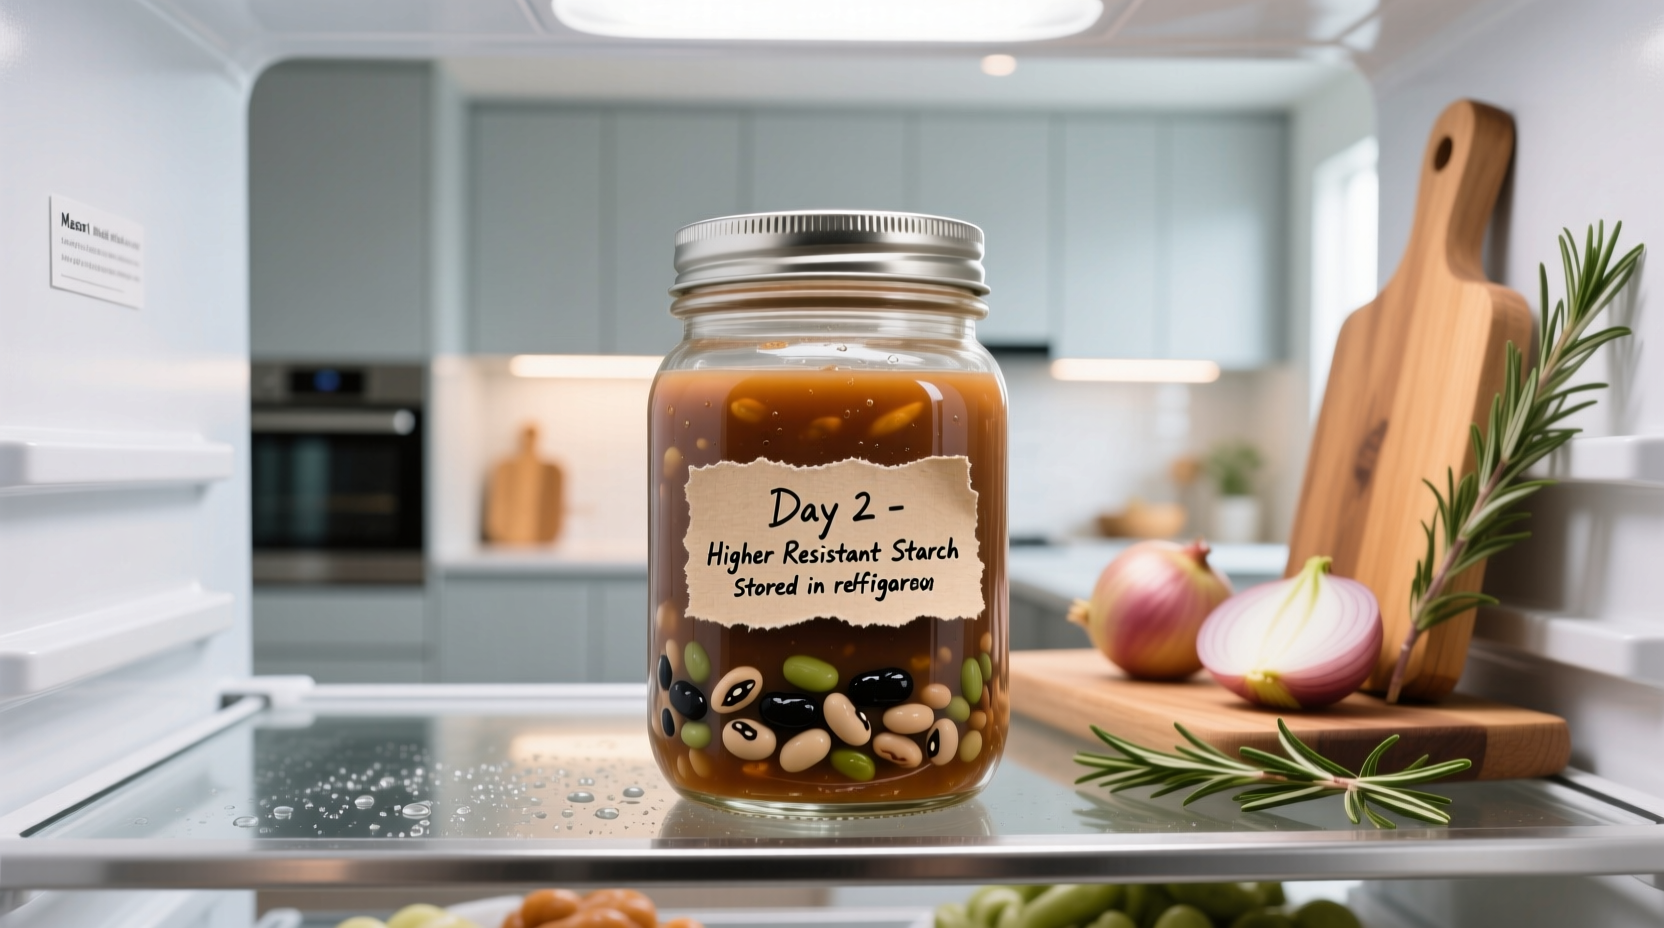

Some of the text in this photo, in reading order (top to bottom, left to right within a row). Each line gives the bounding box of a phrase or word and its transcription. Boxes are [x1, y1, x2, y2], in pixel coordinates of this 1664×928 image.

[768, 487, 839, 540] Day
[852, 491, 876, 522] 2
[707, 537, 959, 574] Higher Resistant Starch
[733, 575, 799, 597] Stored
[807, 577, 825, 595] in
